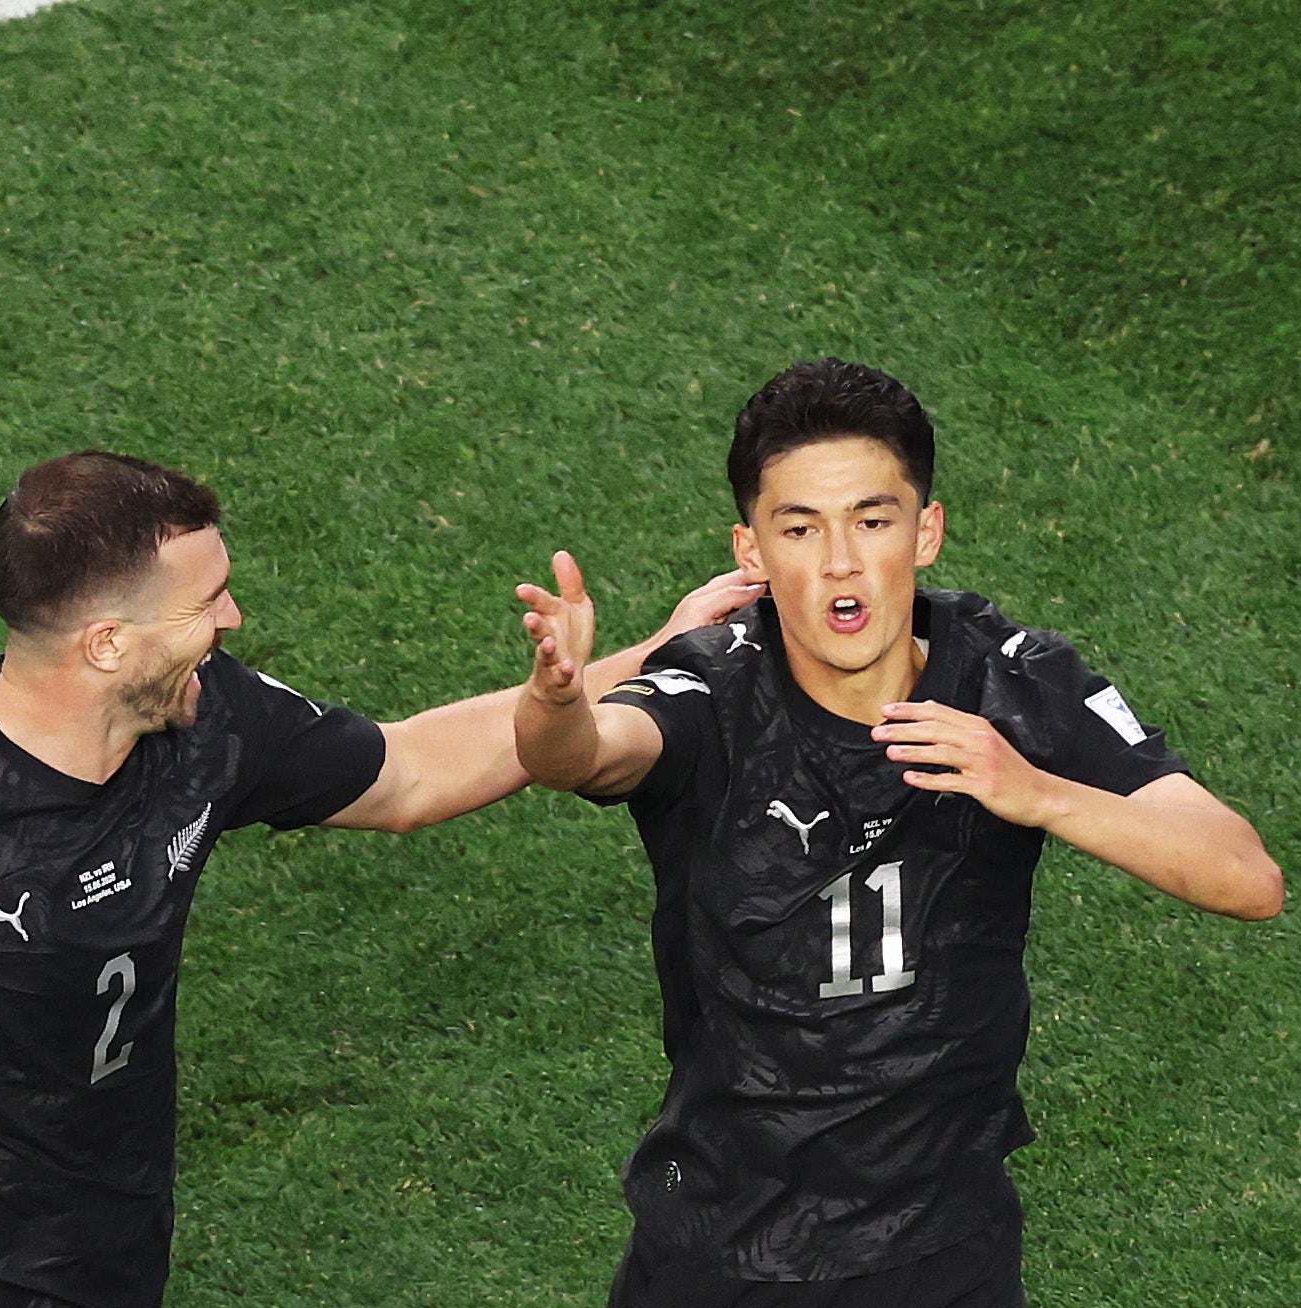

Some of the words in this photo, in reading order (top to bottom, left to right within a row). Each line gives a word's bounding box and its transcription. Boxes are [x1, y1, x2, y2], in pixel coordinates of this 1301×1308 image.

[71, 899, 87, 910] Los
[113, 878, 132, 892] USA
[817, 860, 916, 999] 11
[90, 951, 136, 1084] 2
